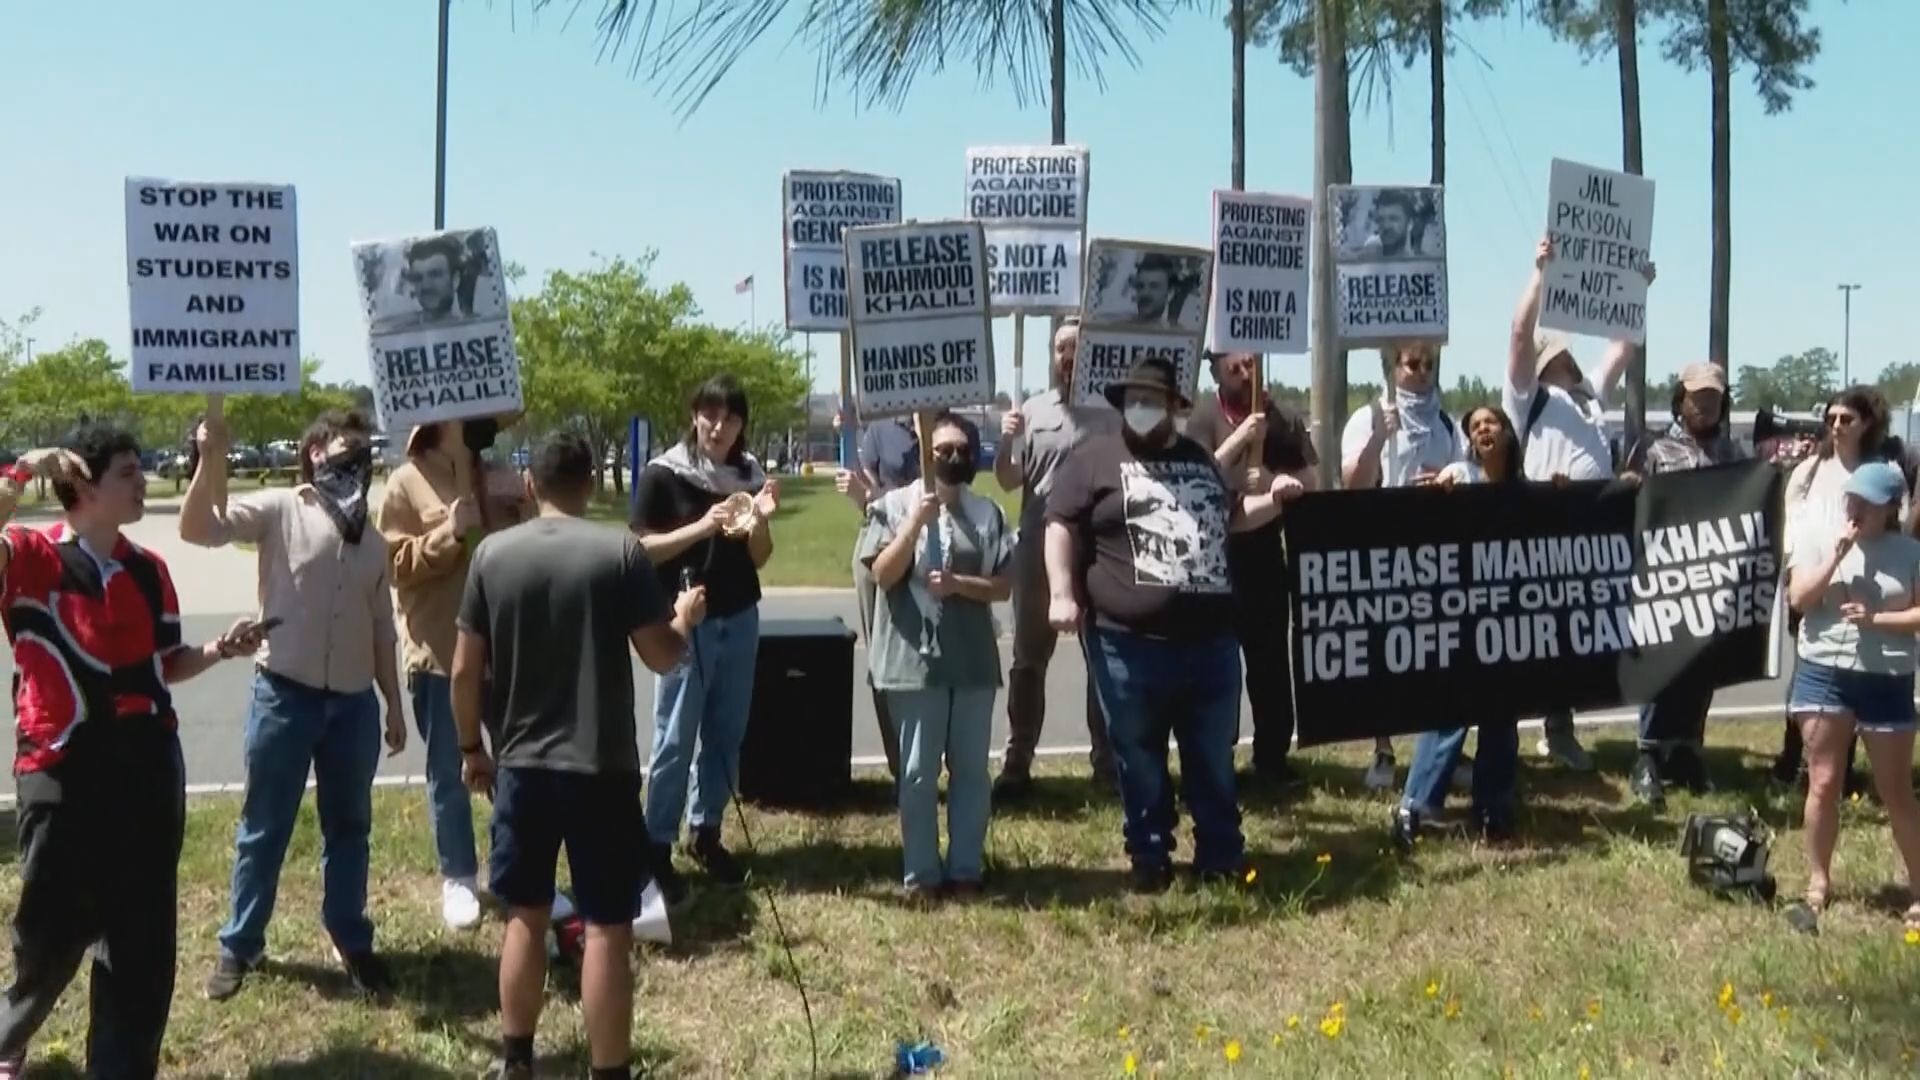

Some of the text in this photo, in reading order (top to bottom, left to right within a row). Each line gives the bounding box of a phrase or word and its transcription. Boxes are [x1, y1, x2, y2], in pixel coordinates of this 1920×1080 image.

[971, 156, 1077, 176] PROTESTING
[791, 181, 894, 205] PROTESTING
[971, 177, 1077, 192] AGAINST
[1579, 173, 1620, 207] JAIL
[139, 187, 283, 210] STOP THE
[971, 193, 1077, 219] GENOCIDE
[793, 203, 895, 221] AGAINST
[1221, 202, 1305, 227] PROTESTING
[1557, 202, 1632, 241] PRISON
[154, 222, 271, 244] WAR ON
[1220, 225, 1304, 243] AGAINST
[861, 233, 971, 269] RELEASE
[986, 244, 1067, 268] S NOT A
[1220, 241, 1304, 270] GENOCIDE
[136, 258, 291, 281] STUDENTS
[803, 264, 823, 289] IS
[863, 264, 973, 295] MAHMOUD
[1349, 273, 1436, 298] RELEASE
[185, 294, 245, 314] AND
[865, 290, 976, 314] KHALIL!
[1226, 288, 1296, 315] IS NOT A
[1348, 297, 1437, 310] MAHMOUD
[1546, 287, 1645, 329] IMMIGRANTS
[1230, 316, 1290, 340] CRIME!
[1350, 308, 1438, 325] KHALIL!
[133, 328, 297, 349] IMMIGRANT
[385, 336, 502, 379] RELEASE
[863, 339, 976, 373] HANDS OFF
[148, 362, 286, 382] FAMILIES!
[388, 366, 505, 394] MAHMOUD
[864, 366, 978, 393] OUR STUDENTS!
[390, 381, 508, 413] KHALIL!
[1300, 511, 1770, 596] RELEASE MAHMOUD KHALIL
[1301, 551, 1775, 630] HANDS OFF OUR STUDENTS
[1302, 582, 1775, 682] ICE OFF OUR CAMPUSES
